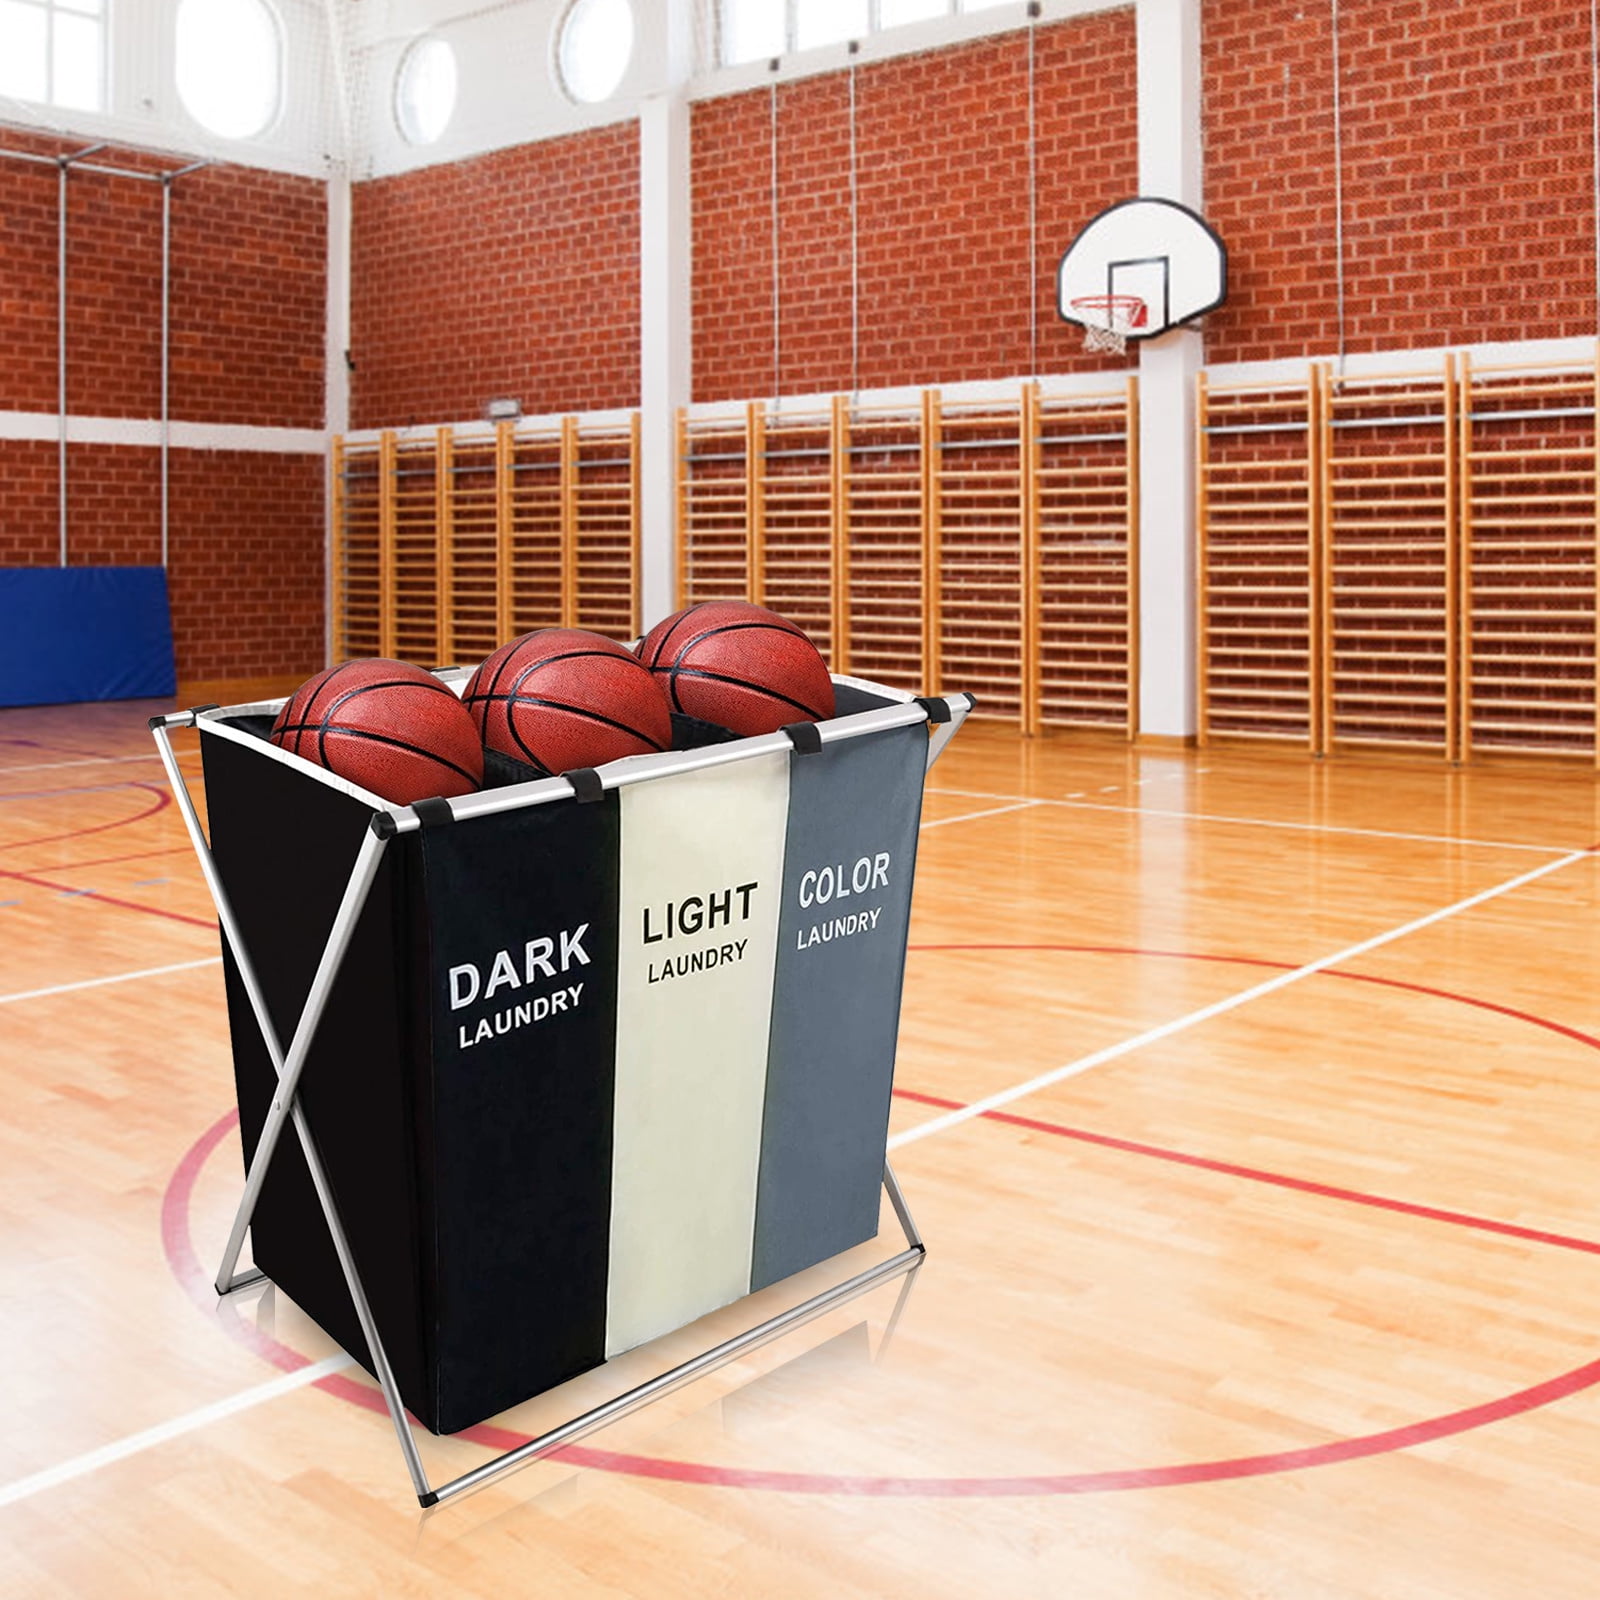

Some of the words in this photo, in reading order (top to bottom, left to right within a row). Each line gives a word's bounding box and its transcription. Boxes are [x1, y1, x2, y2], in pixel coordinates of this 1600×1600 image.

[798, 852, 891, 909] COLOR
[642, 881, 759, 944] LIGHT
[796, 907, 882, 950] LAUNDRY
[448, 923, 591, 1011] DARK
[648, 938, 748, 984] LAUNDRY
[459, 983, 585, 1049] LAUNDRY
